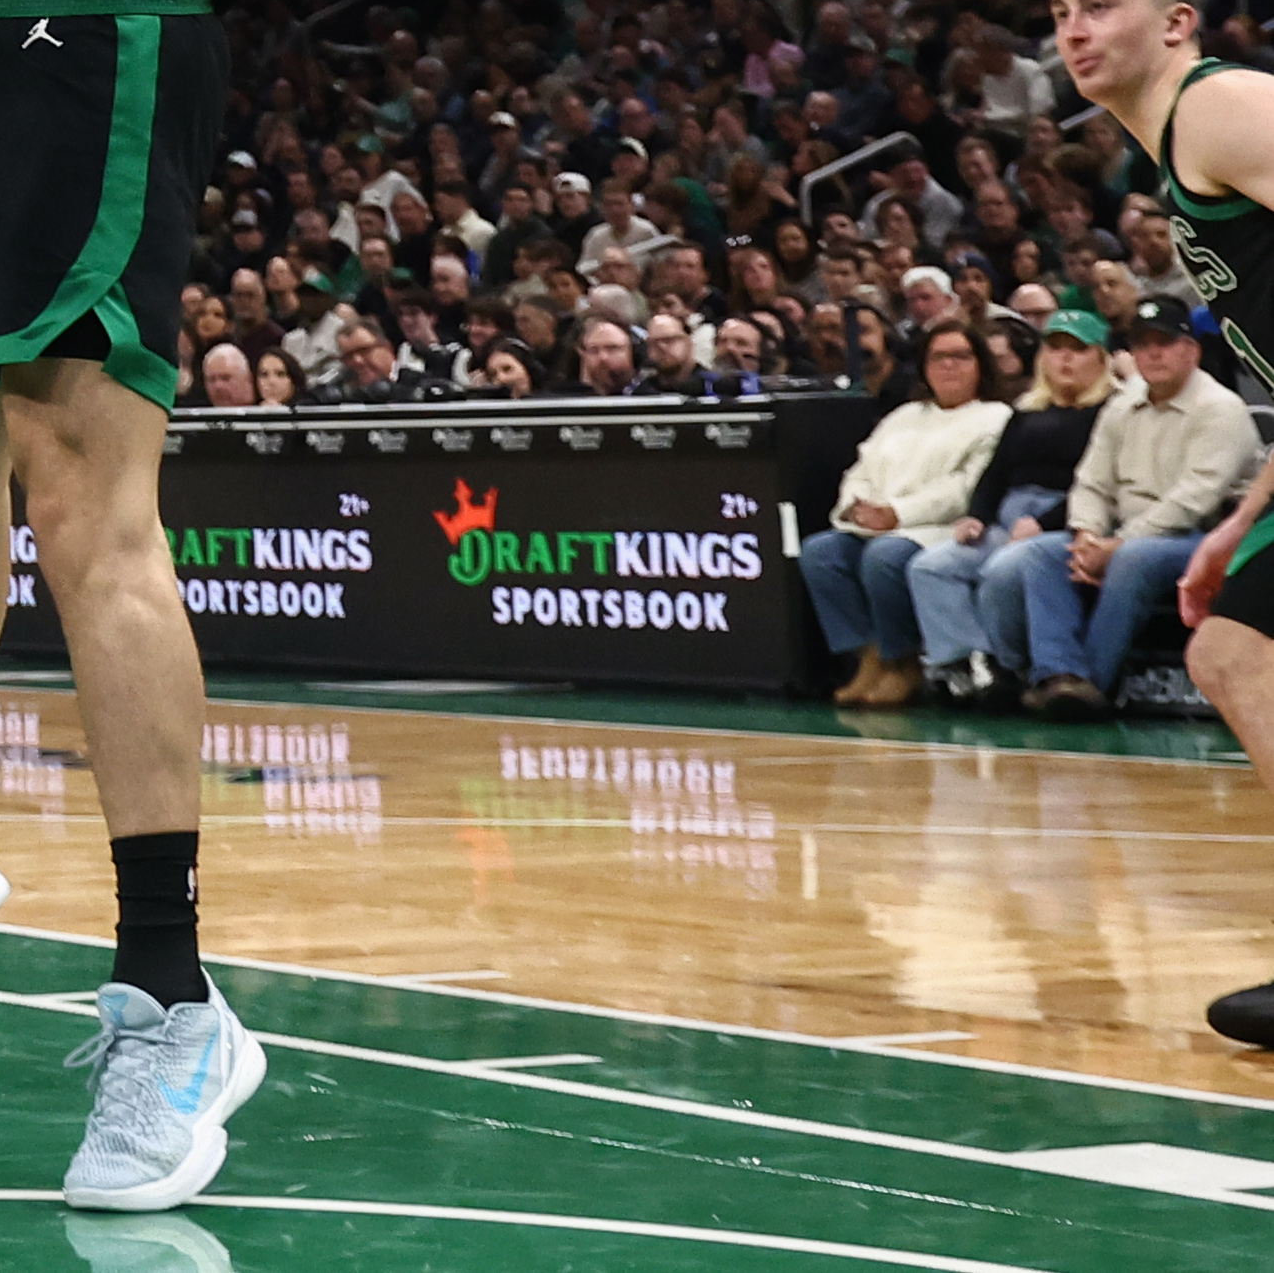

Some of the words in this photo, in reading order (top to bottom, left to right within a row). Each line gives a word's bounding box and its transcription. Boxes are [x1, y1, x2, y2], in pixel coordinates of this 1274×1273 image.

[164, 526, 373, 572] AFTKINGS
[448, 527, 762, 587] DRAFTKINGS
[175, 578, 346, 619] ORTSBOOK
[490, 584, 730, 633] SPORTSBOOK
